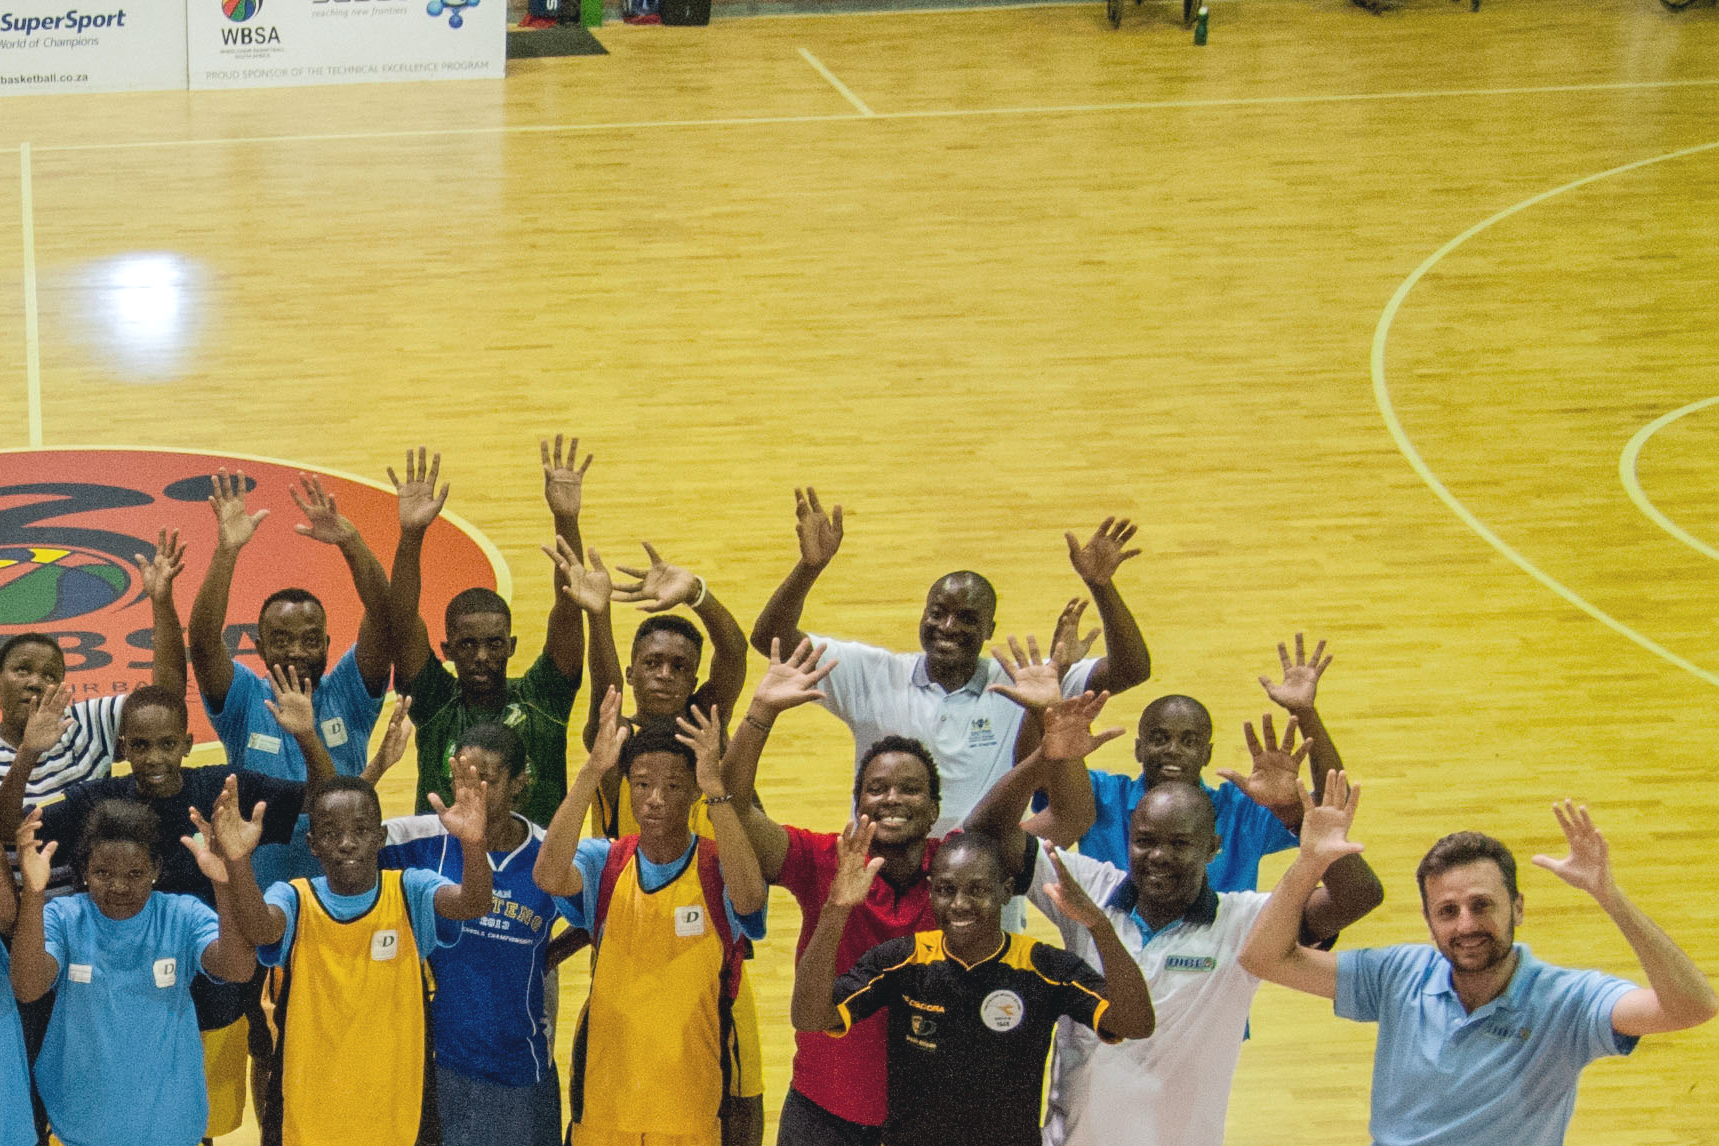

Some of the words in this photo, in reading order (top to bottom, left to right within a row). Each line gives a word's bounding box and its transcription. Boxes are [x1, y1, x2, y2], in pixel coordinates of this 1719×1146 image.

[0, 9, 127, 36] SuperSport
[29, 38, 39, 48] of
[43, 36, 100, 50] Champions
[221, 26, 281, 45] WBSA
[206, 70, 239, 80] PROUD
[242, 67, 288, 80] SPONSOR
[291, 67, 303, 77] OF
[307, 66, 324, 76] THE
[441, 61, 489, 71] PROGRAM
[491, 895, 543, 933] TENG
[686, 911, 699, 923] D
[382, 936, 395, 948] D
[164, 963, 174, 975] D
